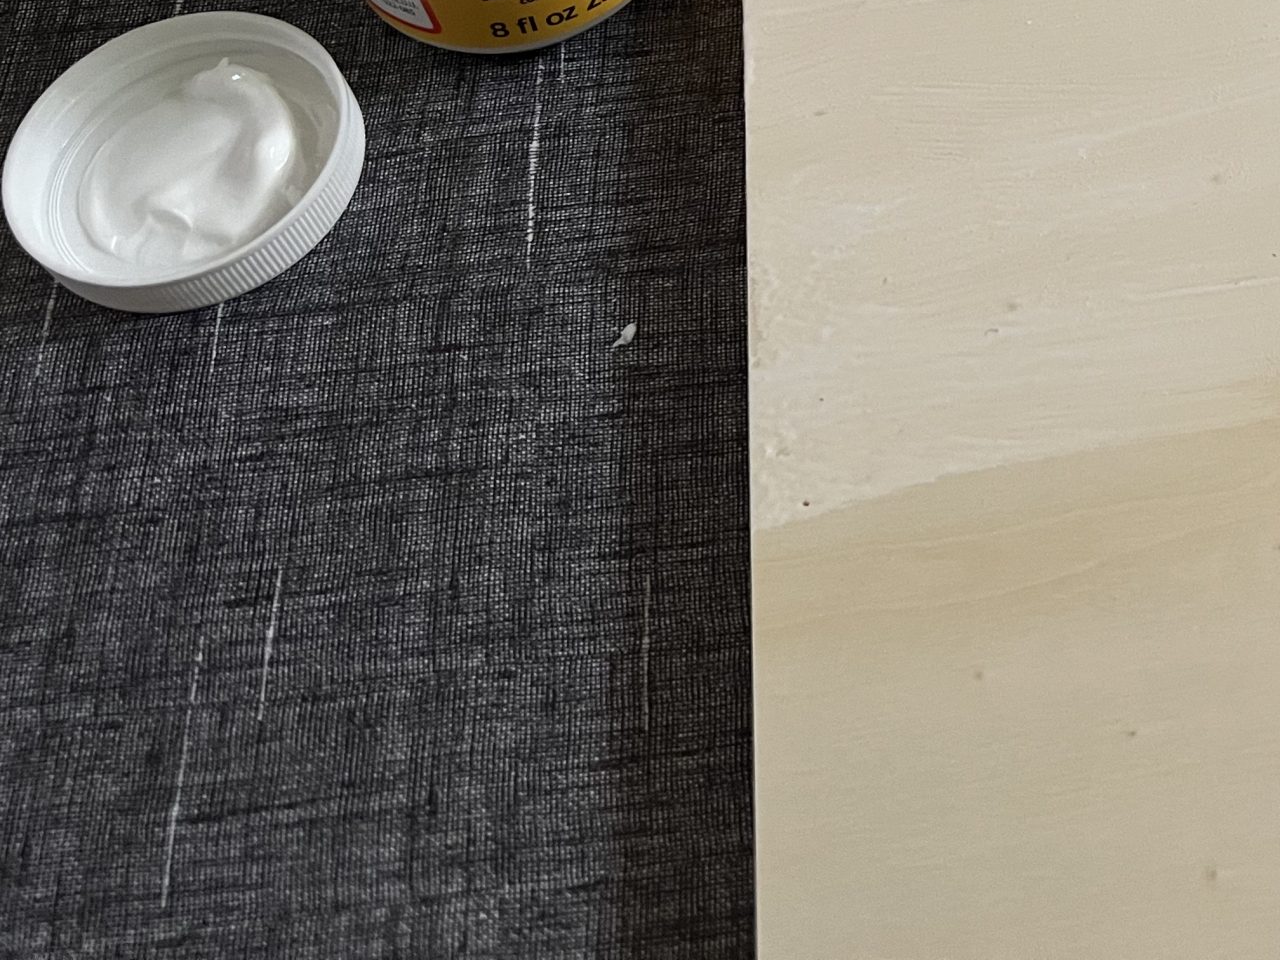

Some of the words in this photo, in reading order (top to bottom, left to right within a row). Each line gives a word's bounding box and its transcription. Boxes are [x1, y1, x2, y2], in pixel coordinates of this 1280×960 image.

[490, 22, 510, 38] 8
[517, 16, 538, 34] fl
[545, 5, 578, 26] oz
